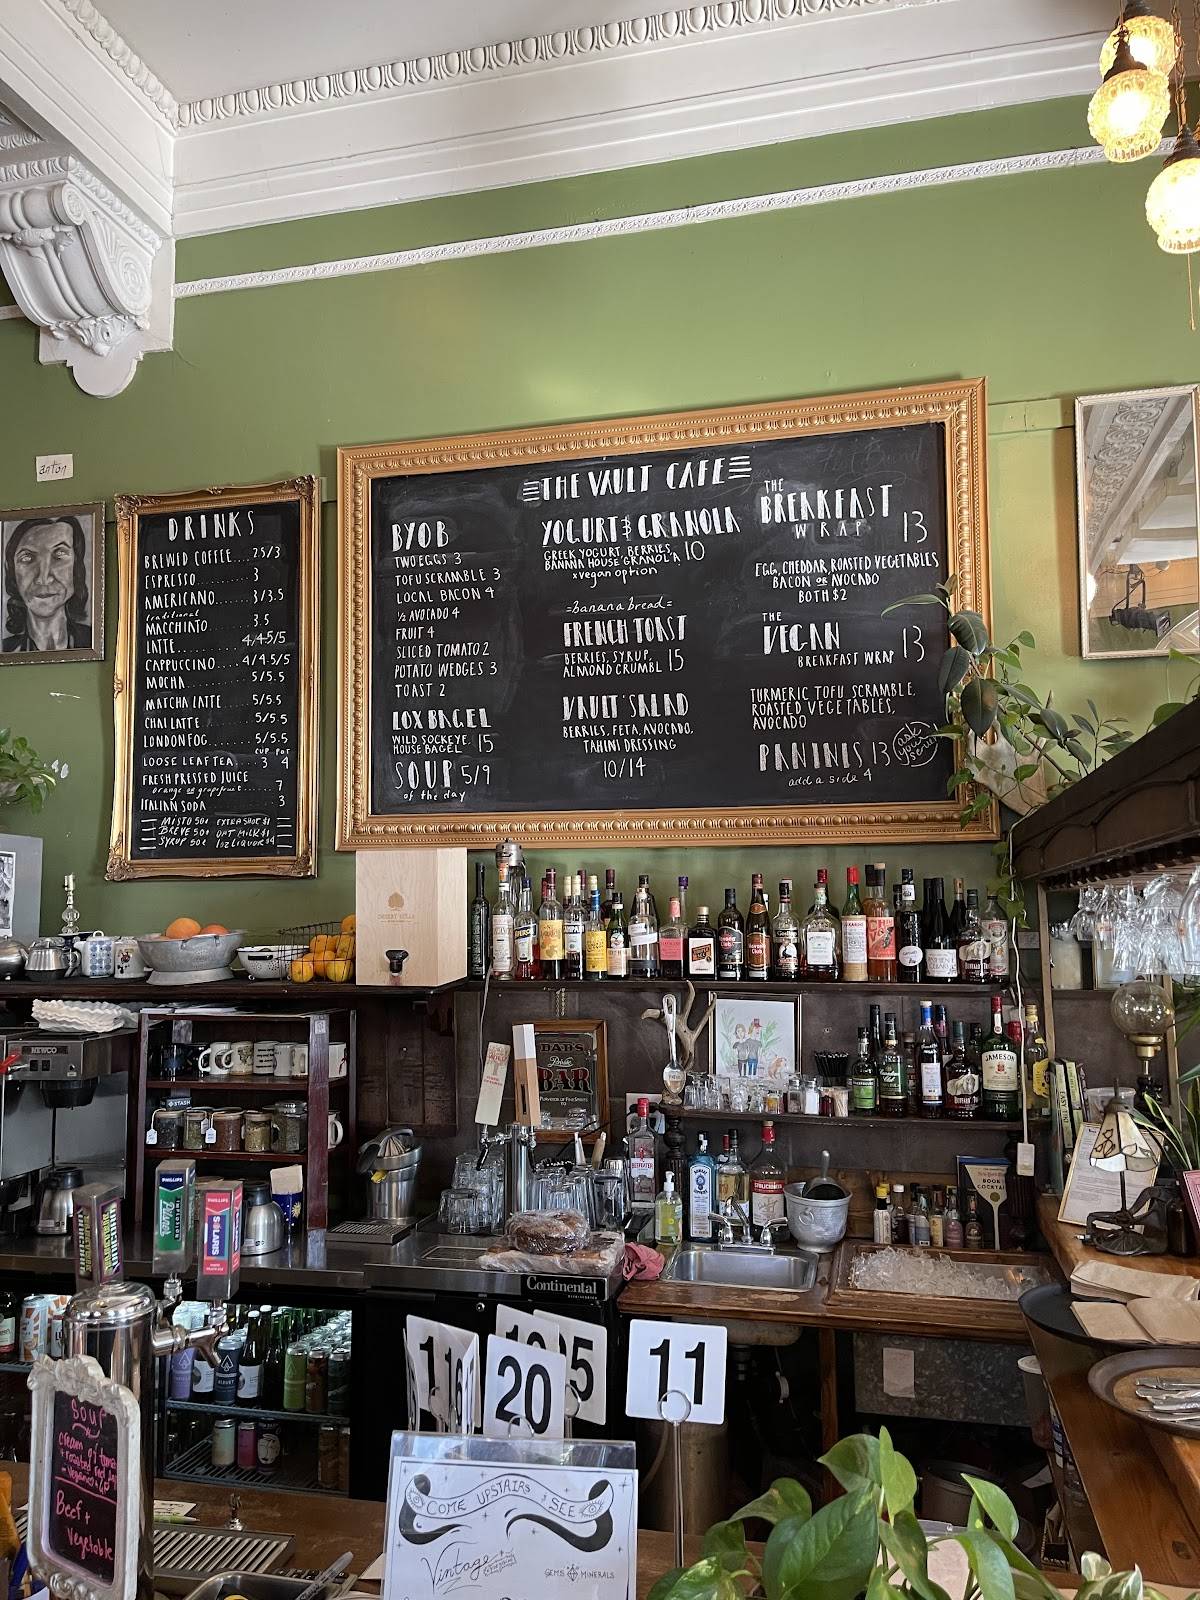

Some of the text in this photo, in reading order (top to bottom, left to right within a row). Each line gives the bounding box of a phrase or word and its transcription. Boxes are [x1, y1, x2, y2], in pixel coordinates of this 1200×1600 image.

[542, 458, 726, 500] THE VAULT CAFE
[764, 478, 784, 494] THE
[760, 484, 893, 524] BREAKFAST
[169, 510, 254, 541] DRINKS
[542, 506, 740, 545] YOGURT GRANOLA
[795, 510, 928, 543] WRAP 13
[392, 520, 448, 552] BYOB
[144, 549, 232, 569] BREWED COFFEE
[544, 540, 705, 560] GREEK 10
[395, 552, 462, 568] TWO EGGS 3
[545, 557, 620, 570] BANANA HOUSE
[831, 556, 872, 573] ROASTED
[874, 552, 940, 570] VEGETABLES
[145, 568, 259, 589] ESPRESSO 3
[395, 568, 500, 586] TOFU SCRAMBLE 3
[615, 566, 658, 584] option
[772, 572, 880, 589] BACON AVOCADO
[145, 590, 215, 610] AMERICANO
[396, 586, 494, 604] LOCAL BACON 4
[798, 588, 848, 603] BOTH $2
[409, 606, 460, 622] AVOCADO 4
[762, 612, 782, 622] THE
[146, 614, 270, 636] MACCHIATO 3.5
[396, 626, 434, 640] FRUIT 4
[564, 614, 687, 646] FRENCH TOAST
[146, 639, 175, 655] LATTE
[396, 642, 490, 659] SLICED TOMATO 2
[764, 622, 924, 662] VEGAN 13
[145, 658, 216, 672] CAPPUCCINO
[668, 648, 684, 672] 15
[798, 650, 894, 668] BREAKFAST WRAP
[394, 662, 498, 679] POTATO WEDGES 3
[564, 663, 612, 678] ALMOND
[146, 676, 186, 690] MOCHA
[395, 682, 446, 698] TOAST 2
[146, 696, 188, 710] MATCHA
[192, 695, 221, 709] LATTE
[750, 686, 808, 703] TURMERIC
[814, 686, 844, 700] TOFU
[562, 693, 689, 720] VAULT SALAD
[752, 701, 802, 717] ROASTED
[144, 717, 168, 730] CHAI
[170, 717, 200, 730] LATTE
[392, 708, 492, 730] LOX BAGEL
[753, 715, 807, 730] AVOCADO
[144, 735, 186, 748] LONDON
[188, 734, 208, 746] FOG
[392, 734, 494, 752] WILD 15
[394, 744, 462, 754] HOUSE BAGEL
[583, 738, 676, 754] TAHINI DRESSING
[144, 756, 234, 766] LOOSE LEAF TEA
[760, 742, 890, 772] PANINIS 13
[395, 760, 490, 790] SOUP 5/9
[603, 756, 646, 778] 10/14
[142, 771, 248, 786] FRESH PRESSED JUICE
[788, 768, 872, 787] add side 4
[141, 798, 206, 812] ITALIAN SODA
[404, 790, 466, 802] of the day
[985, 1054, 1016, 1062] JAMESON
[174, 1100, 190, 1108] STASH
[526, 1276, 597, 1294] Continental
[650, 1338, 706, 1406] 11
[496, 1355, 552, 1434] 20
[426, 1480, 576, 1518] COME UPSTAIRS SEE
[421, 1541, 490, 1595] Vintage
[545, 1568, 615, 1578] GEMS MINERALS
